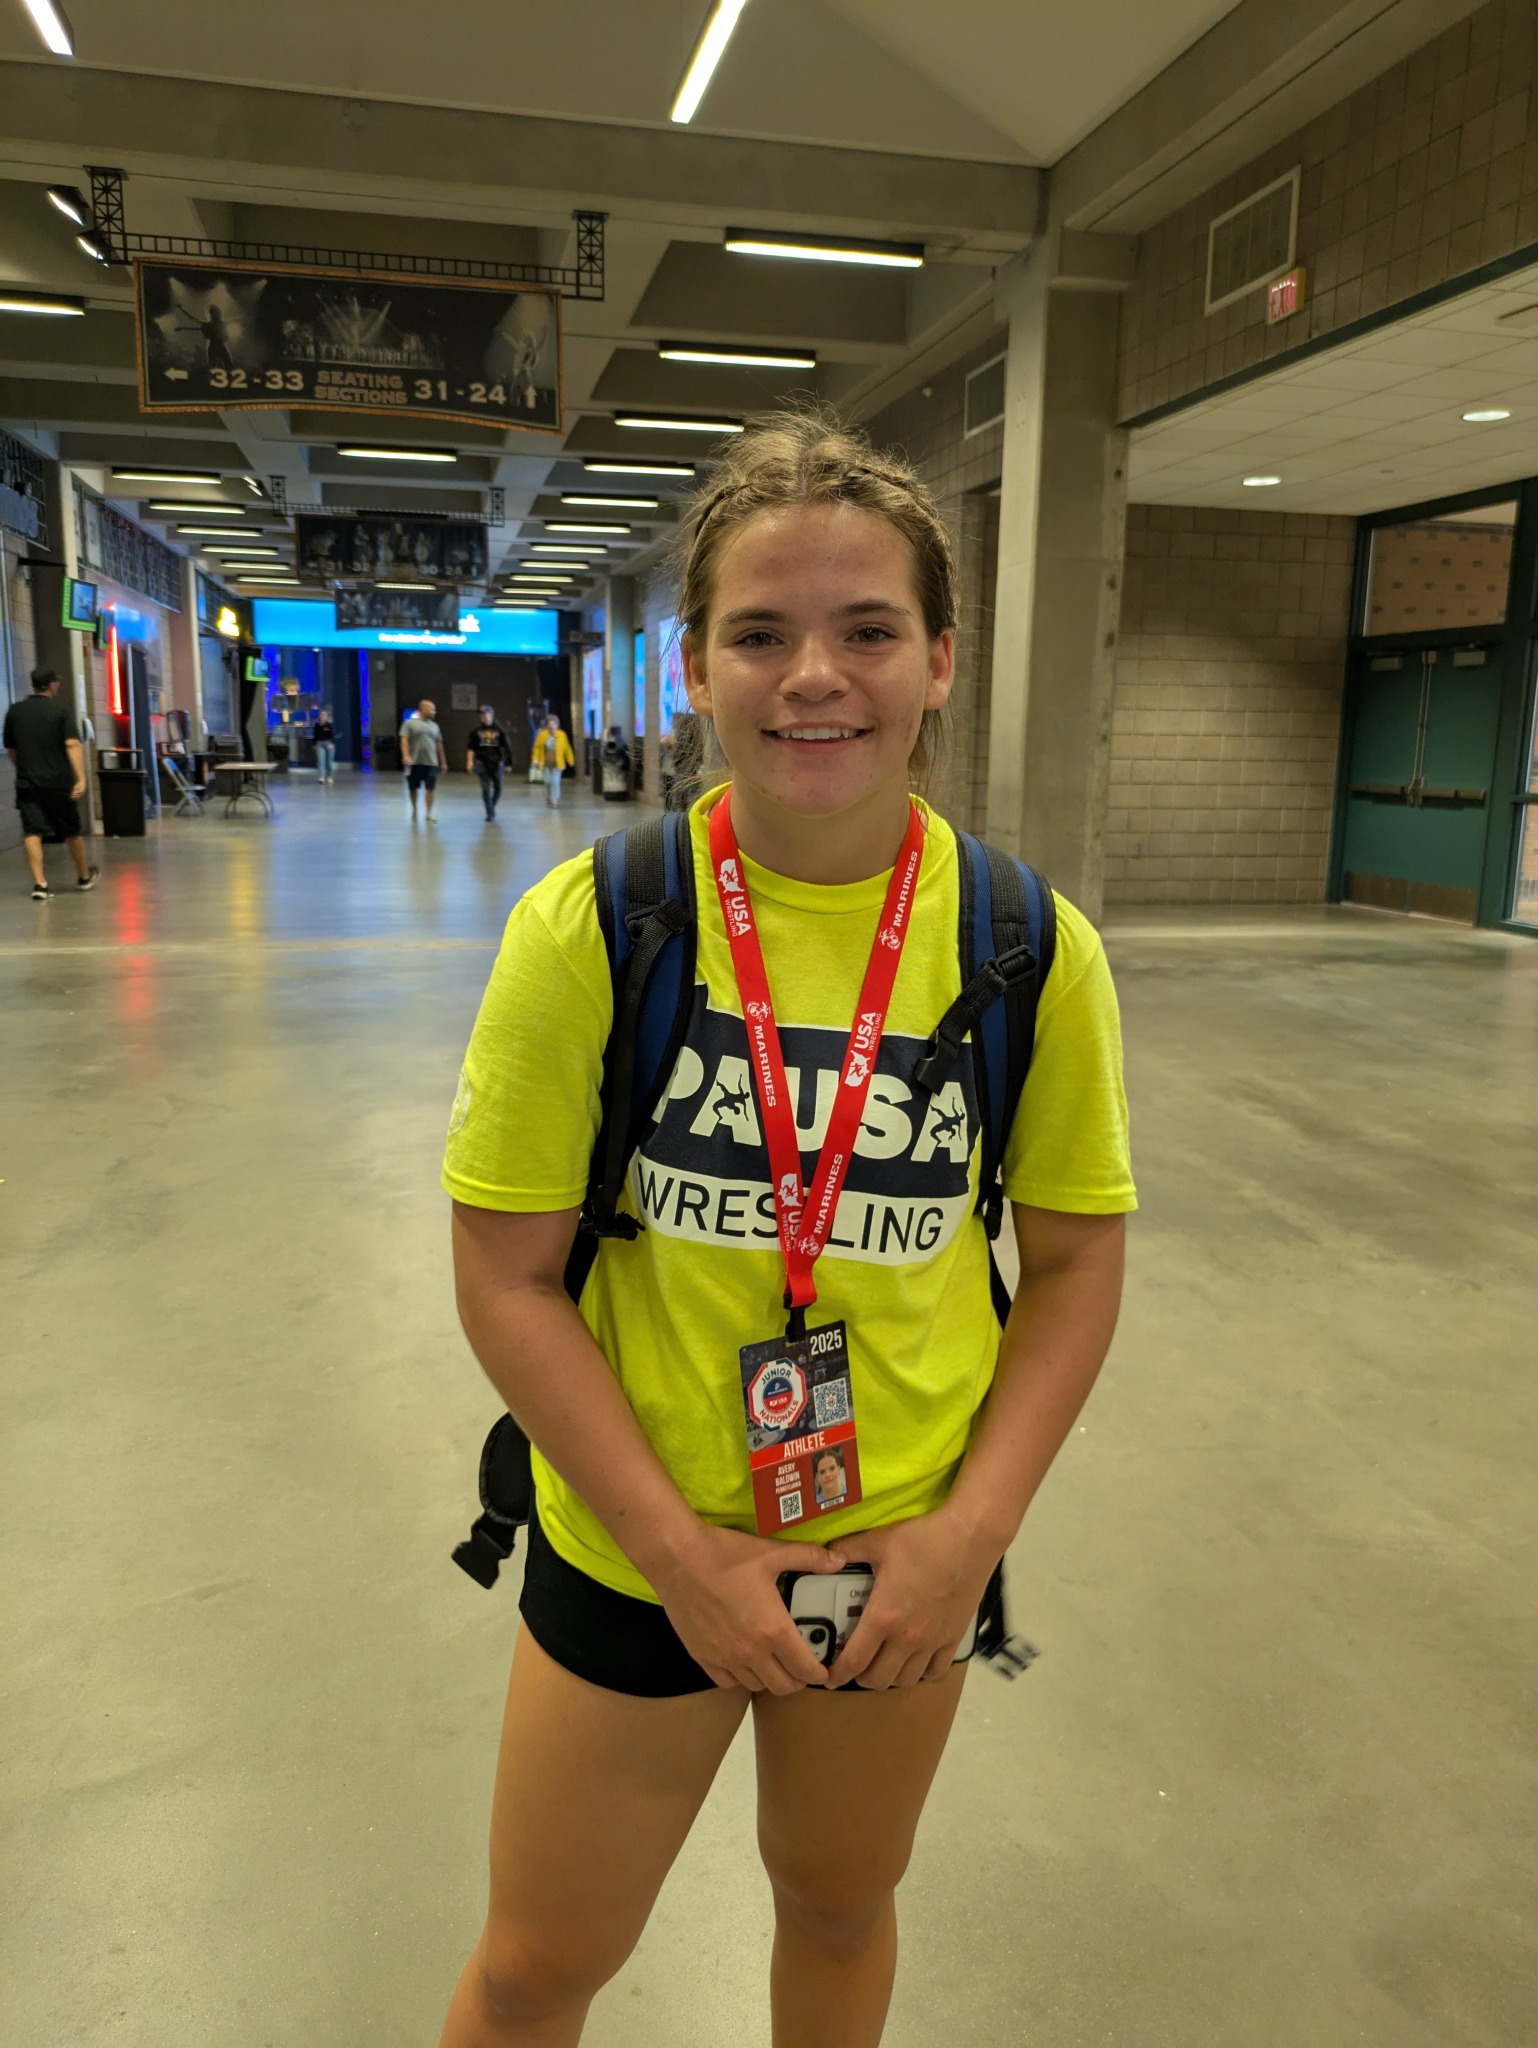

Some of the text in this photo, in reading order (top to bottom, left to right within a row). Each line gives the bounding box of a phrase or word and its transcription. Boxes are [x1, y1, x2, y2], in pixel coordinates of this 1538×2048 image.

[313, 386, 408, 405] SECTIONS
[316, 370, 404, 390] SEATING
[893, 851, 918, 928] MARINES
[725, 898, 738, 937] WRESTLING
[731, 896, 751, 936] USA
[854, 1012, 876, 1049] USA
[867, 1013, 882, 1051] WRESTLING
[754, 1025, 777, 1107] MARINES
[638, 1161, 944, 1253] WRESLING
[814, 1154, 843, 1234] MARINES
[810, 1329, 842, 1355] 2025
[761, 1368, 792, 1384] JUNIOR
[760, 1401, 799, 1423] NATIONALS
[784, 1431, 825, 1459] ATHLETE
[775, 1471, 800, 1487] BALDWIN
[778, 1462, 795, 1475] AVERY
